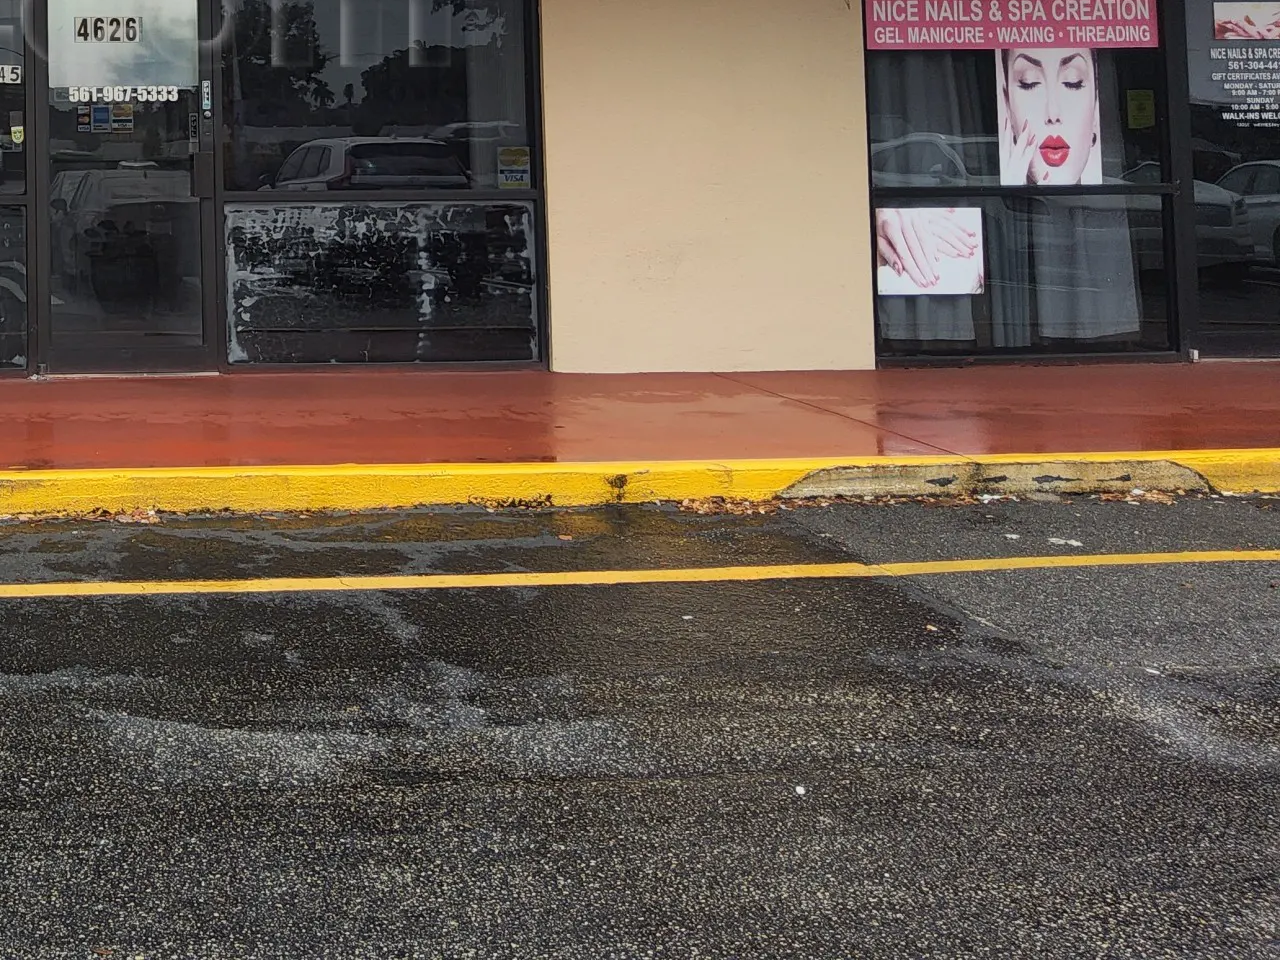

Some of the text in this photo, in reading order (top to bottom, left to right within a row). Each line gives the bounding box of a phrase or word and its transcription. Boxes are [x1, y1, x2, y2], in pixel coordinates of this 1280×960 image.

[872, 0, 919, 22] NICE
[924, 0, 984, 22] NAILS
[988, 0, 1003, 22] &
[1007, 0, 1047, 21] SPA
[76, 17, 138, 42] 4626
[874, 25, 1151, 44] GEL MANICURE WAXING THREADING
[1210, 48, 1226, 59] NICE
[1227, 48, 1247, 59] NAILS
[1248, 48, 1253, 59] &
[1254, 48, 1268, 59] SPA
[69, 85, 179, 102] 561-967-5333
[1221, 112, 1260, 120] WALK-INS
[504, 174, 524, 182] VISA
